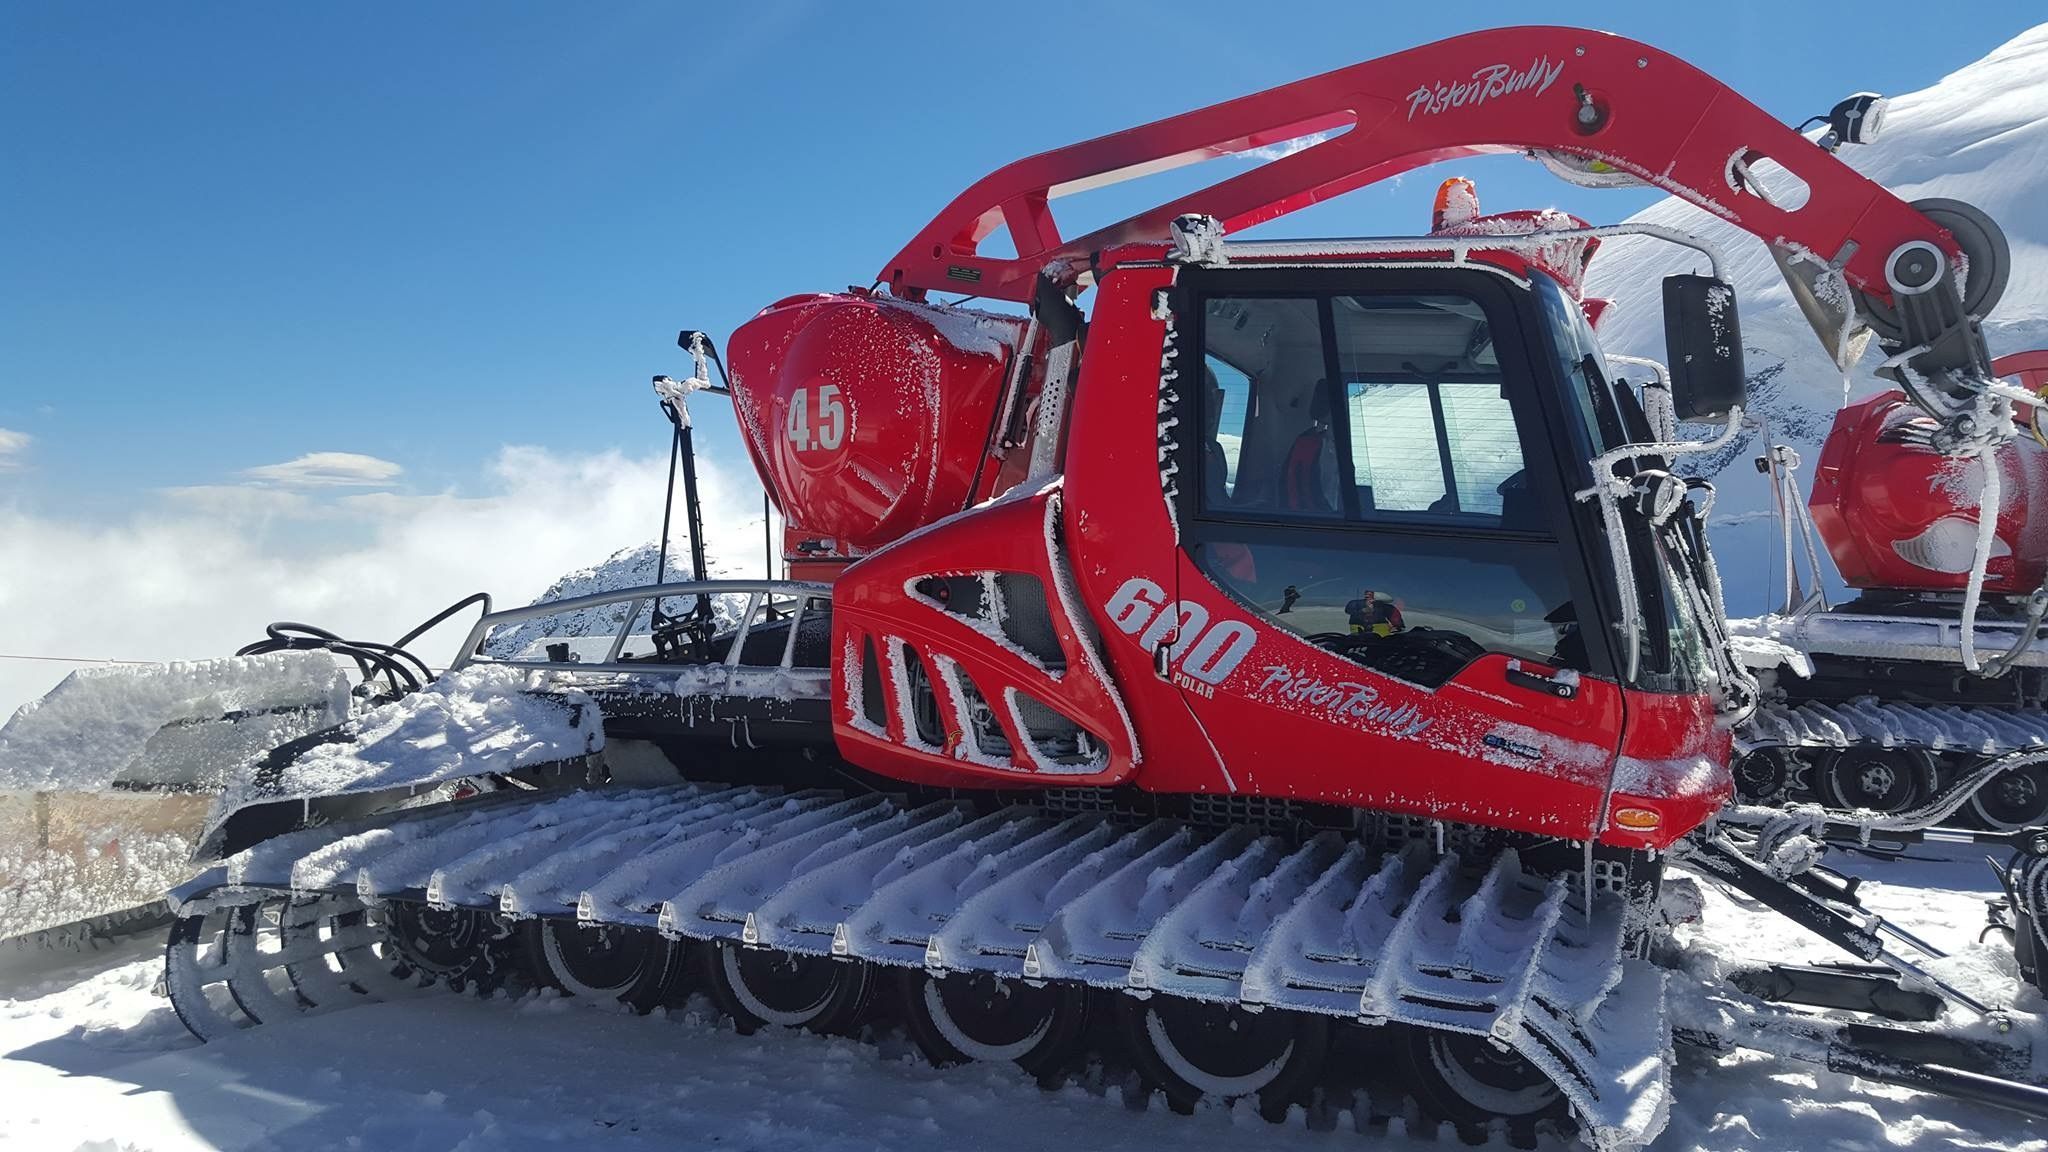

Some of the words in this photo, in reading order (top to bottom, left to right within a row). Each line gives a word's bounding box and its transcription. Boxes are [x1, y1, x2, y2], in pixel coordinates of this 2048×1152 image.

[1406, 54, 1565, 122] PistenBully
[787, 384, 844, 452] 4.5
[1104, 577, 1258, 686] 600
[1173, 671, 1214, 699] POLAR
[1260, 664, 1434, 736] PistenBully
